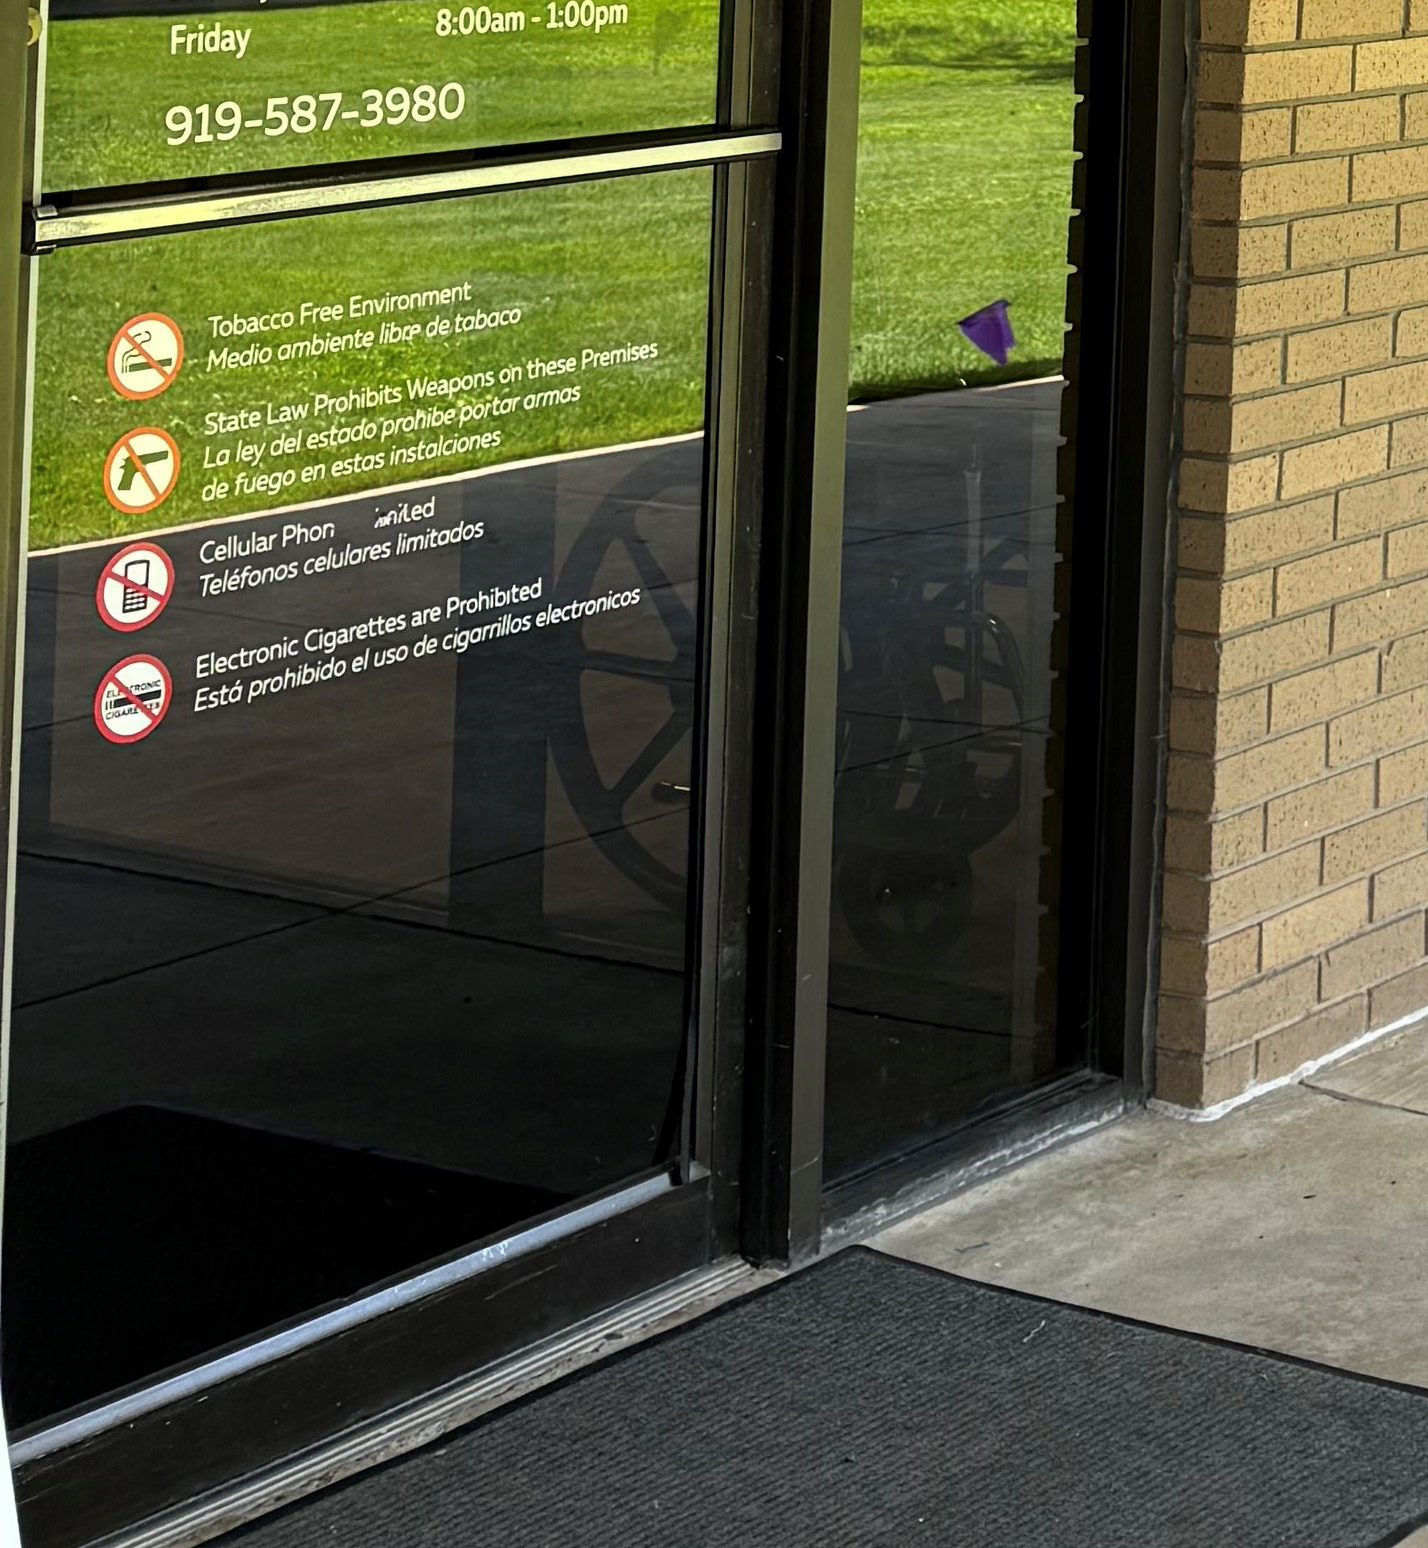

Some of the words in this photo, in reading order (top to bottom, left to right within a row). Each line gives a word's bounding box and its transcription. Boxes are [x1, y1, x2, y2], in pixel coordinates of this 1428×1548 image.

[170, 22, 252, 60] Friday
[435, 4, 525, 37] 8:00am
[164, 82, 466, 146] 919-587-3980
[206, 343, 272, 372] Medio
[277, 328, 374, 361] ambiente
[379, 322, 421, 345] libre
[425, 316, 451, 338] de
[454, 307, 522, 334] tabaco
[207, 310, 295, 338] Tobacco
[299, 302, 344, 326] Free
[349, 281, 472, 318] Environment
[204, 409, 262, 436] State
[267, 402, 310, 425] Law
[314, 384, 403, 417] Prohibits
[406, 369, 495, 400] Weapons
[498, 364, 522, 383] on
[526, 356, 577, 379] these
[581, 341, 659, 370] Premises
[203, 446, 230, 469] La
[235, 440, 266, 467] ley
[270, 429, 302, 457] del
[306, 417, 377, 450] estado
[380, 406, 456, 442] prohibe
[458, 395, 521, 429] portar
[523, 385, 581, 410] armas
[201, 477, 229, 502] de
[233, 469, 296, 496] fuego
[300, 463, 326, 483] en
[330, 452, 386, 478] estas
[388, 429, 502, 466] instalciones
[199, 532, 278, 565] Cellular
[281, 522, 336, 548] Phon
[199, 561, 299, 598] Teléfonos
[302, 540, 392, 576] celulares
[395, 520, 485, 556] limitados
[193, 679, 244, 712] Está
[247, 657, 347, 704] prohibido
[351, 647, 370, 673] el
[373, 645, 409, 668] uso
[412, 634, 439, 658] de
[441, 613, 532, 653] cigarrillos
[535, 587, 641, 628] electronicos
[195, 636, 299, 679] Electronic
[303, 612, 407, 654] Cigarettes
[410, 605, 442, 628] are
[446, 577, 543, 620] Prohibited
